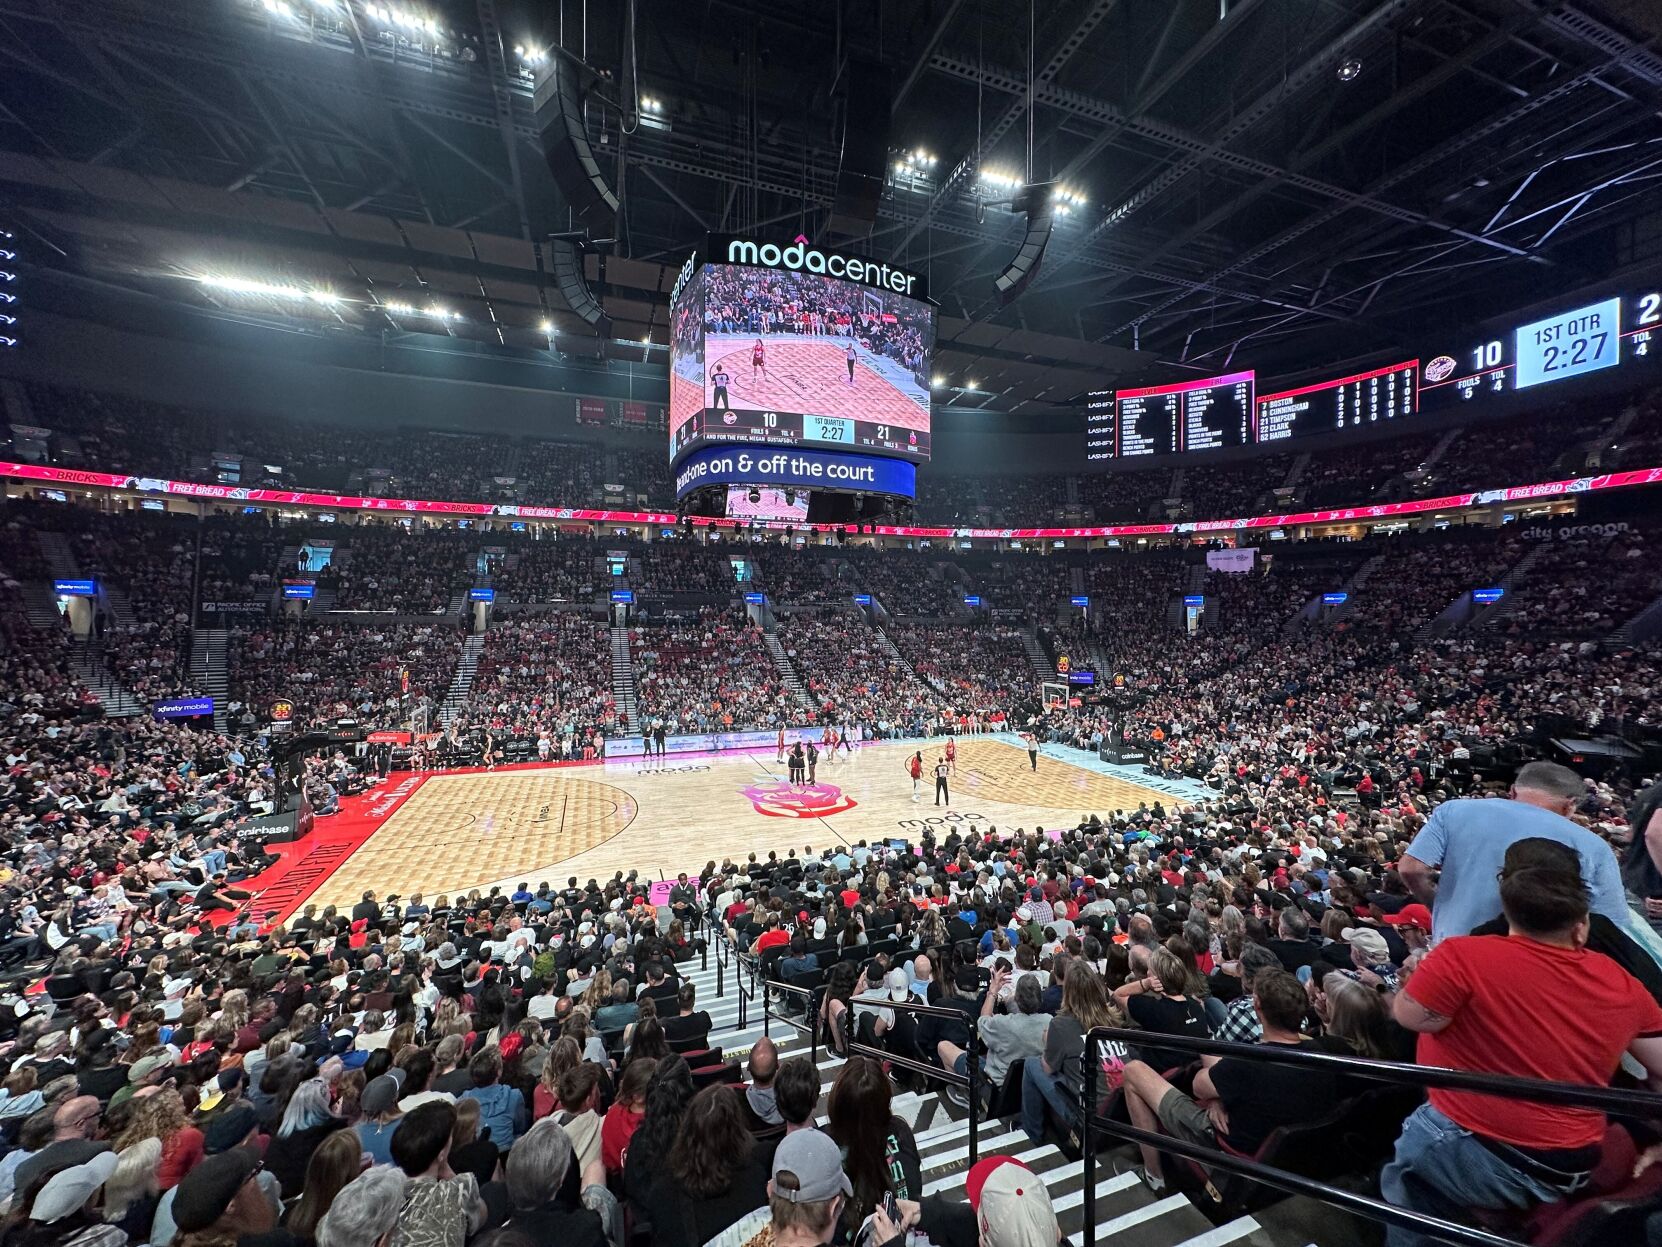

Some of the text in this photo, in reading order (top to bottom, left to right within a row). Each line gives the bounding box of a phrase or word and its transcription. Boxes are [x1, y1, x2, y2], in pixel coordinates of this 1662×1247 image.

[1534, 313, 1601, 345] 1ST QTR
[1632, 331, 1652, 343] TOL
[1473, 341, 1502, 370] 10
[1543, 332, 1609, 373] 2:27
[1635, 344, 1648, 356] 4
[1491, 370, 1506, 381] TOL
[1270, 397, 1293, 408] BOSTON
[1338, 386, 1344, 394] 4
[1356, 382, 1360, 390] 1
[1371, 378, 1377, 386] 0
[1405, 369, 1410, 377] 0
[1458, 376, 1480, 390] FOULS
[1493, 380, 1502, 392] 4
[1464, 387, 1473, 399] 5
[763, 413, 777, 428] 10
[824, 418, 845, 426] QUARTER
[1270, 422, 1289, 432] CLARK
[1371, 404, 1377, 412] 3
[1270, 413, 1295, 424] TIMPSON
[821, 426, 844, 440] 2:27
[877, 425, 889, 440] 21
[1270, 430, 1291, 440] HARRIS
[710, 459, 732, 474] on
[738, 454, 753, 472] &
[758, 455, 788, 474] off
[791, 457, 822, 476] the
[826, 464, 875, 482] court
[56, 471, 98, 483] BRICKS
[173, 484, 224, 497] FREE BREAD
[1510, 484, 1563, 498] FREE BREAD
[451, 503, 476, 512] BRICKS
[1423, 499, 1451, 510] BRICKS
[521, 507, 556, 517] FREE BREAD
[158, 703, 209, 713] xfinity mobile
[1121, 752, 1144, 760] coinbase
[897, 812, 986, 828] moda
[236, 825, 290, 838] coinbase
